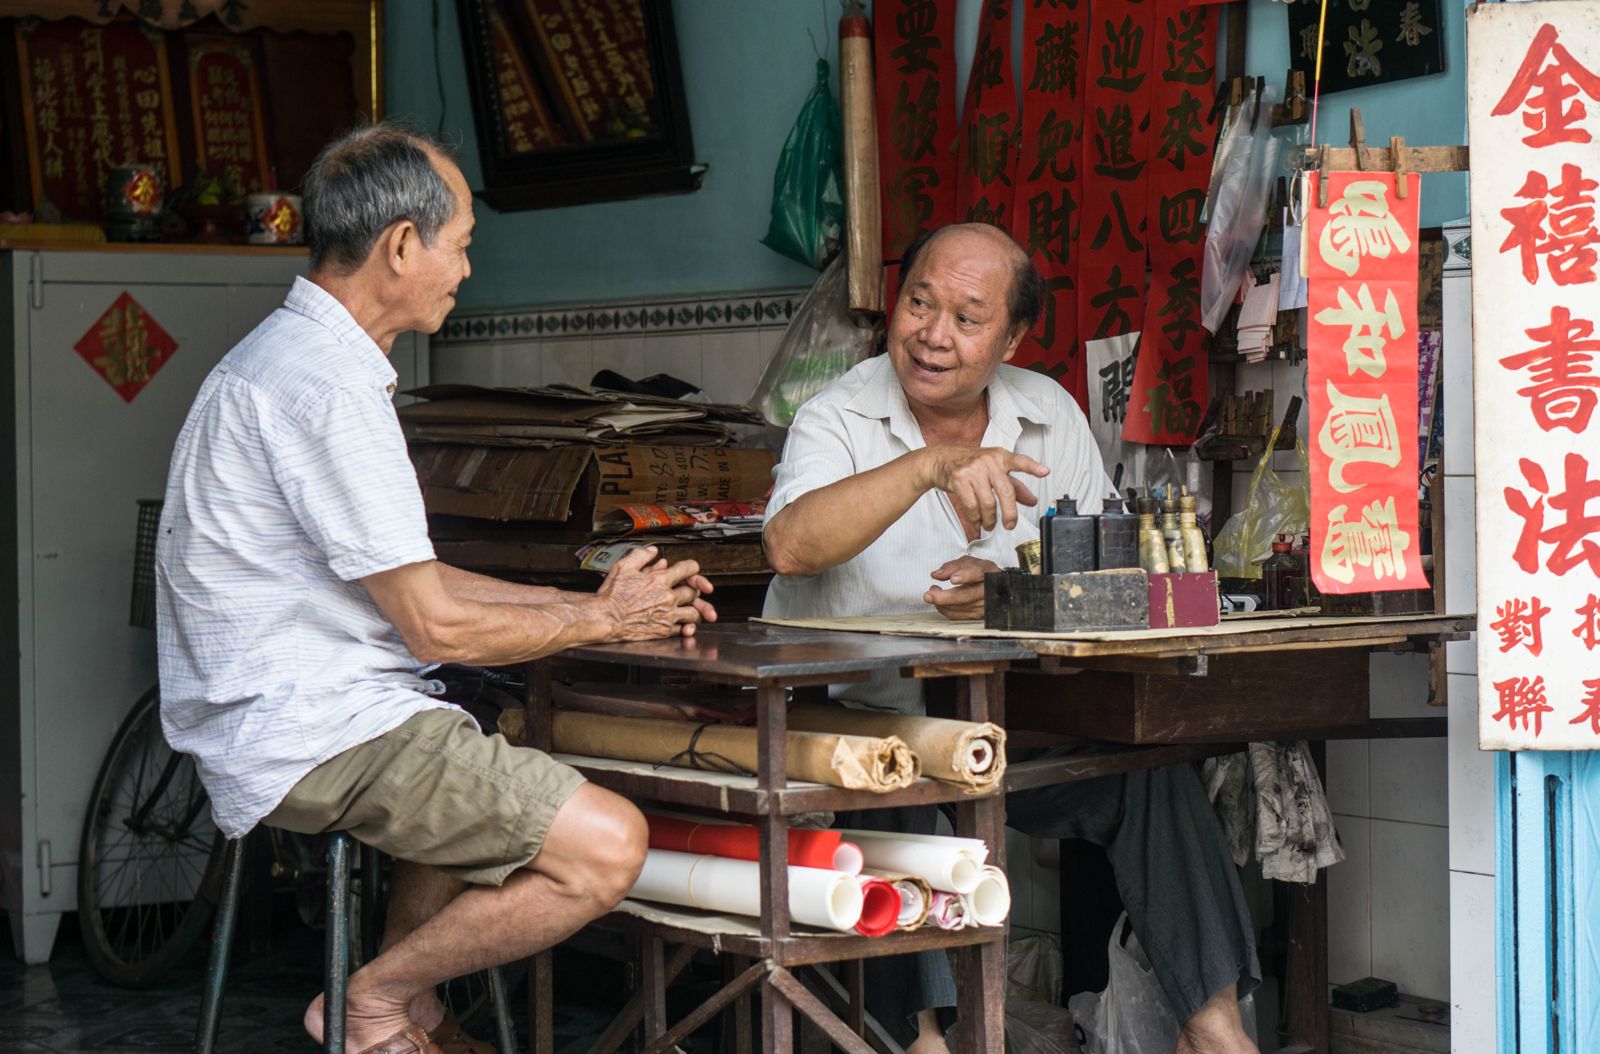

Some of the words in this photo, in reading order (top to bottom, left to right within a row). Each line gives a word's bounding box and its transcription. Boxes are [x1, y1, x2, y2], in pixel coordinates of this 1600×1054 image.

[1395, 1, 1433, 47] 春
[965, 0, 1012, 232] 和順
[1090, 0, 1149, 341] 迎進八方
[1142, 8, 1215, 437] 送來四季福
[1490, 23, 1600, 577] 金禧書法
[600, 445, 633, 496] PLA
[717, 477, 731, 502] ADE
[718, 461, 730, 472] IN
[1490, 596, 1555, 738] 對聯
